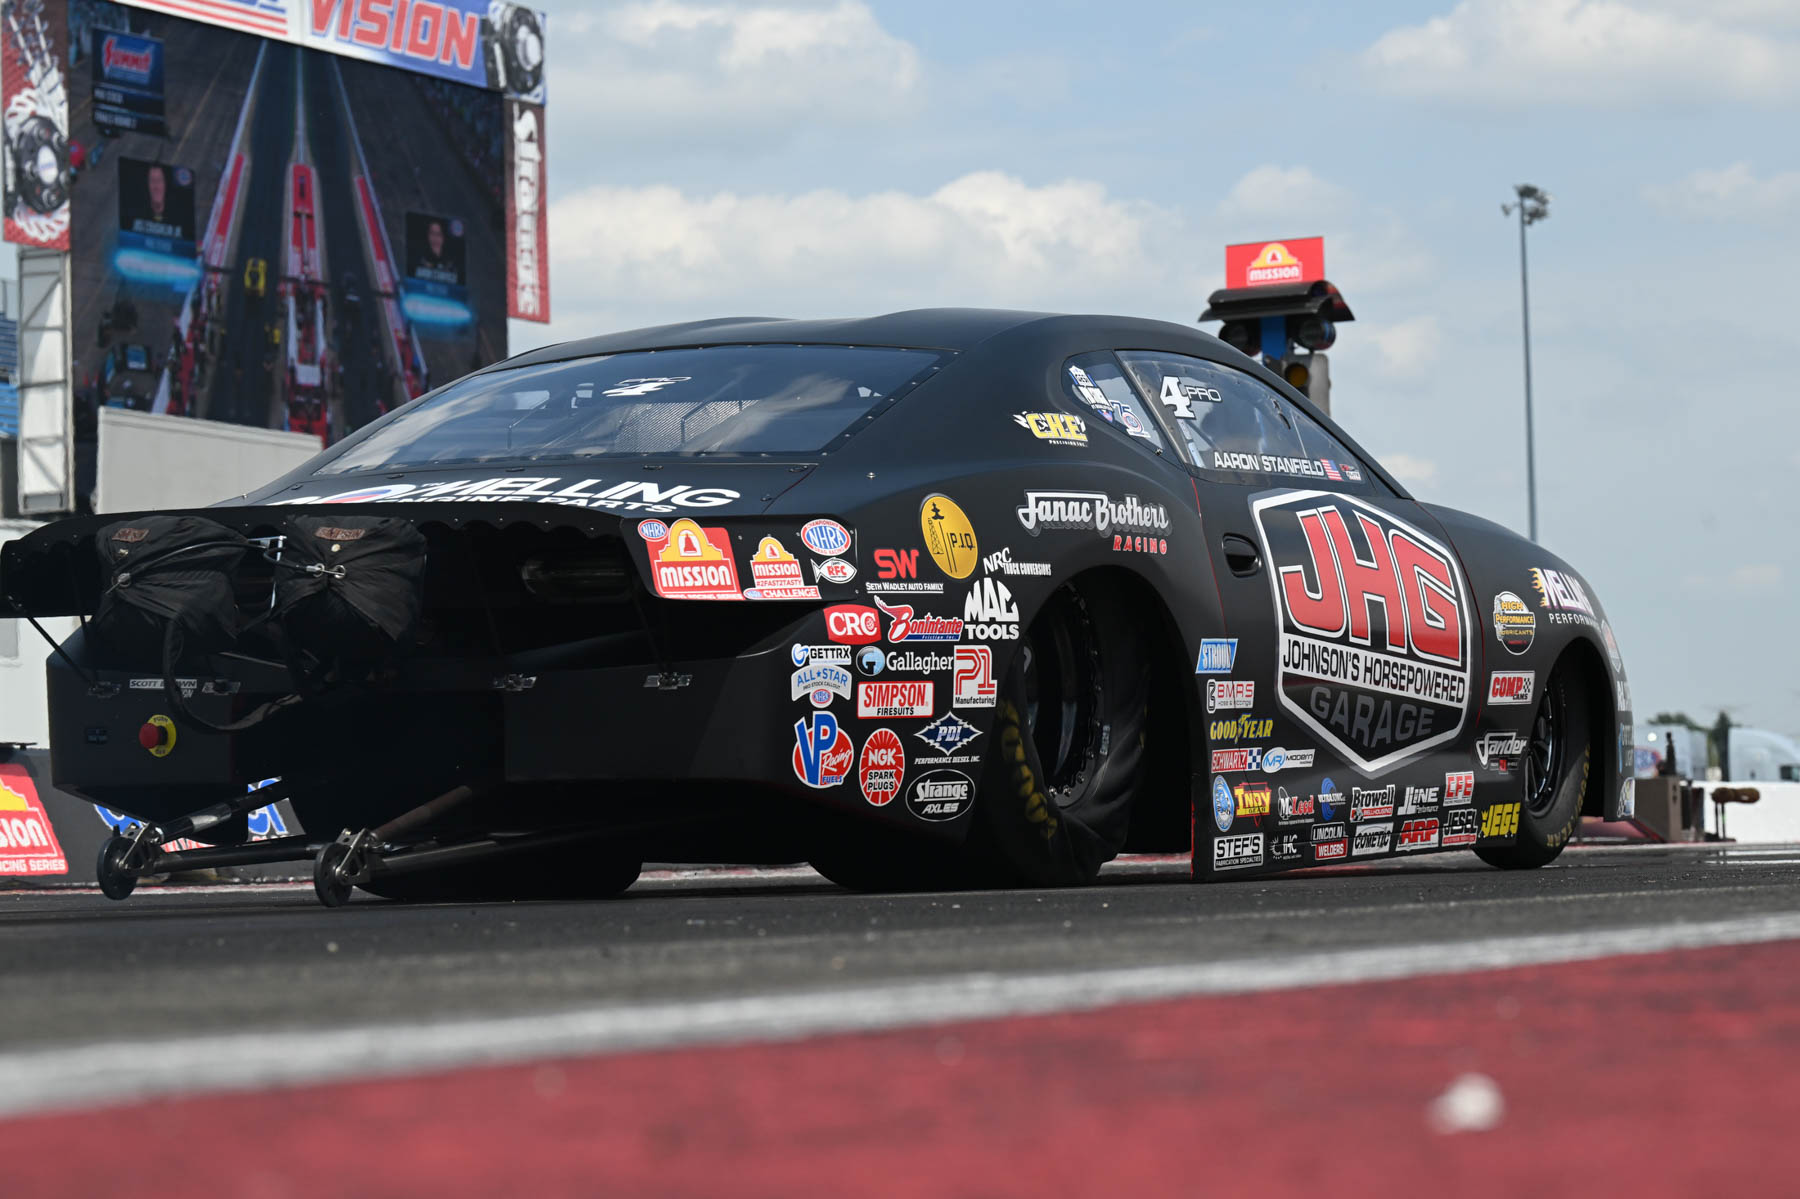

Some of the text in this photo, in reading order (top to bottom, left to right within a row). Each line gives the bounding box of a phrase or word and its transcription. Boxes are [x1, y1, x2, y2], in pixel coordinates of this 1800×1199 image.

[308, 0, 478, 69] VISION
[1160, 376, 1222, 418] 4 PRO
[1214, 452, 1260, 471] AARON
[1261, 456, 1325, 476] STANFIELD
[384, 477, 741, 507] MELLING
[538, 496, 677, 513] PARTS
[1094, 493, 1169, 531] Brothers
[641, 525, 666, 538] NHRA
[808, 526, 846, 550] NHRA
[1113, 535, 1167, 555] RACING
[827, 565, 847, 576] RFC
[874, 549, 919, 579] SW
[983, 547, 1051, 576] NRC TRUCK CONVERSIONS
[763, 588, 817, 598] CHALLENGE
[882, 582, 907, 591] WADLEY
[924, 583, 943, 591] FAMILY
[1279, 505, 1462, 667] JHG
[964, 577, 1019, 622] MAC
[1501, 601, 1524, 611] HIGH
[829, 612, 878, 636] CRC
[889, 606, 963, 641] Boninfante
[1496, 613, 1533, 624] PERFORMANCE
[1549, 612, 1601, 632] PERFORM
[964, 624, 1020, 640] TOOLS
[810, 648, 850, 659] GETTRX
[887, 652, 953, 675] Gallagher
[797, 668, 848, 687] ALL STAR
[1283, 639, 1465, 703] JOHNSON'S HORSEPOWERED
[131, 680, 160, 688] SCOTT
[1492, 676, 1523, 698] COMP
[864, 684, 926, 708] SIMPSON
[955, 696, 995, 706] Manufacturing
[1513, 693, 1528, 701] CAMS
[877, 706, 914, 716] FIRESUITS
[1310, 687, 1435, 748] GARAGE
[937, 725, 962, 742] PDI
[794, 711, 838, 785] VP
[868, 749, 896, 766] NGK
[822, 748, 852, 772] Racing
[822, 775, 843, 784] FUELS
[867, 781, 894, 791] PLUGS
[868, 771, 894, 781] SPARK
[1446, 775, 1473, 797] CFE
[914, 779, 968, 803] Strange
[1353, 785, 1394, 808] Browell
[922, 803, 959, 814] AXLES
[1280, 795, 1315, 816] McLeod
[1443, 808, 1478, 836] JESEL
[1481, 803, 1520, 837] JEGS
[0, 818, 48, 848] SION
[1313, 825, 1343, 841] LINCOLN
[1355, 830, 1392, 850] COMETIC
[1400, 819, 1439, 845] ARP
[1216, 835, 1261, 858] STEF'S
[1318, 843, 1345, 857] WELDERS
[0, 859, 66, 872] CING SERIES
